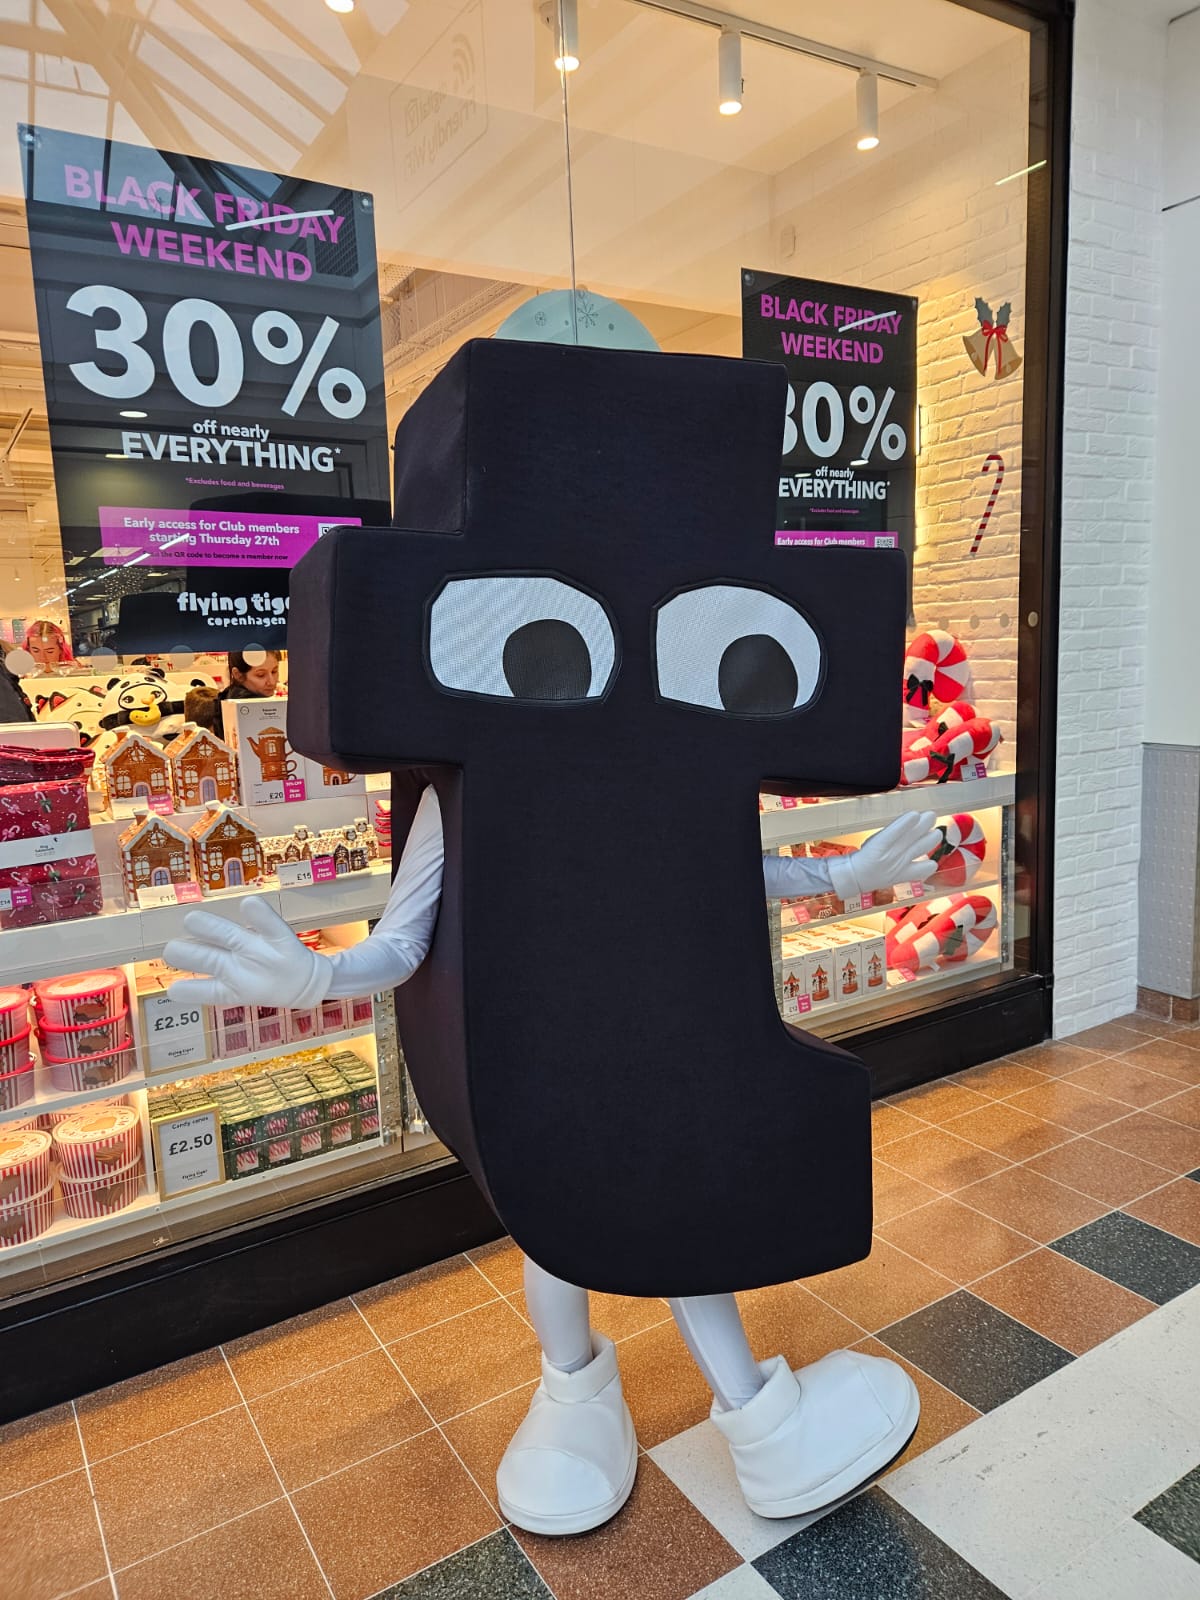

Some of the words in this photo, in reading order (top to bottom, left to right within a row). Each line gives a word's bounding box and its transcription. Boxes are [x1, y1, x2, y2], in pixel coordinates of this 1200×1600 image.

[64, 164, 203, 220] BLACK
[214, 192, 345, 244] FRIDAY
[111, 221, 312, 282] WEEKEND
[760, 294, 828, 327] BLACK
[834, 305, 902, 335] FRIDAY
[66, 284, 367, 419] 30%
[781, 332, 884, 364] WEEKEND
[193, 420, 217, 435] off
[220, 423, 270, 442] nearly
[816, 466, 829, 478] off
[830, 467, 854, 481] nearly
[220, 478, 236, 487] food
[251, 481, 285, 491] beverages
[123, 517, 154, 530] Early
[158, 520, 197, 530] access
[199, 520, 215, 531] for
[218, 521, 246, 532] Club
[248, 523, 300, 534] members
[150, 532, 197, 545] starting
[199, 533, 252, 547] Thursday
[254, 535, 280, 546] 27th
[777, 537, 794, 546] Early
[794, 538, 813, 546] access
[814, 537, 823, 546] for
[823, 537, 838, 546] Club
[838, 537, 865, 546] members
[246, 552, 273, 560] member
[177, 591, 248, 616] flying
[207, 615, 286, 627] copenhagen
[297, 872, 312, 881] £15
[154, 1010, 200, 1031] £2.50
[172, 1121, 190, 1129] Candy
[169, 1133, 213, 1155] £2.50
